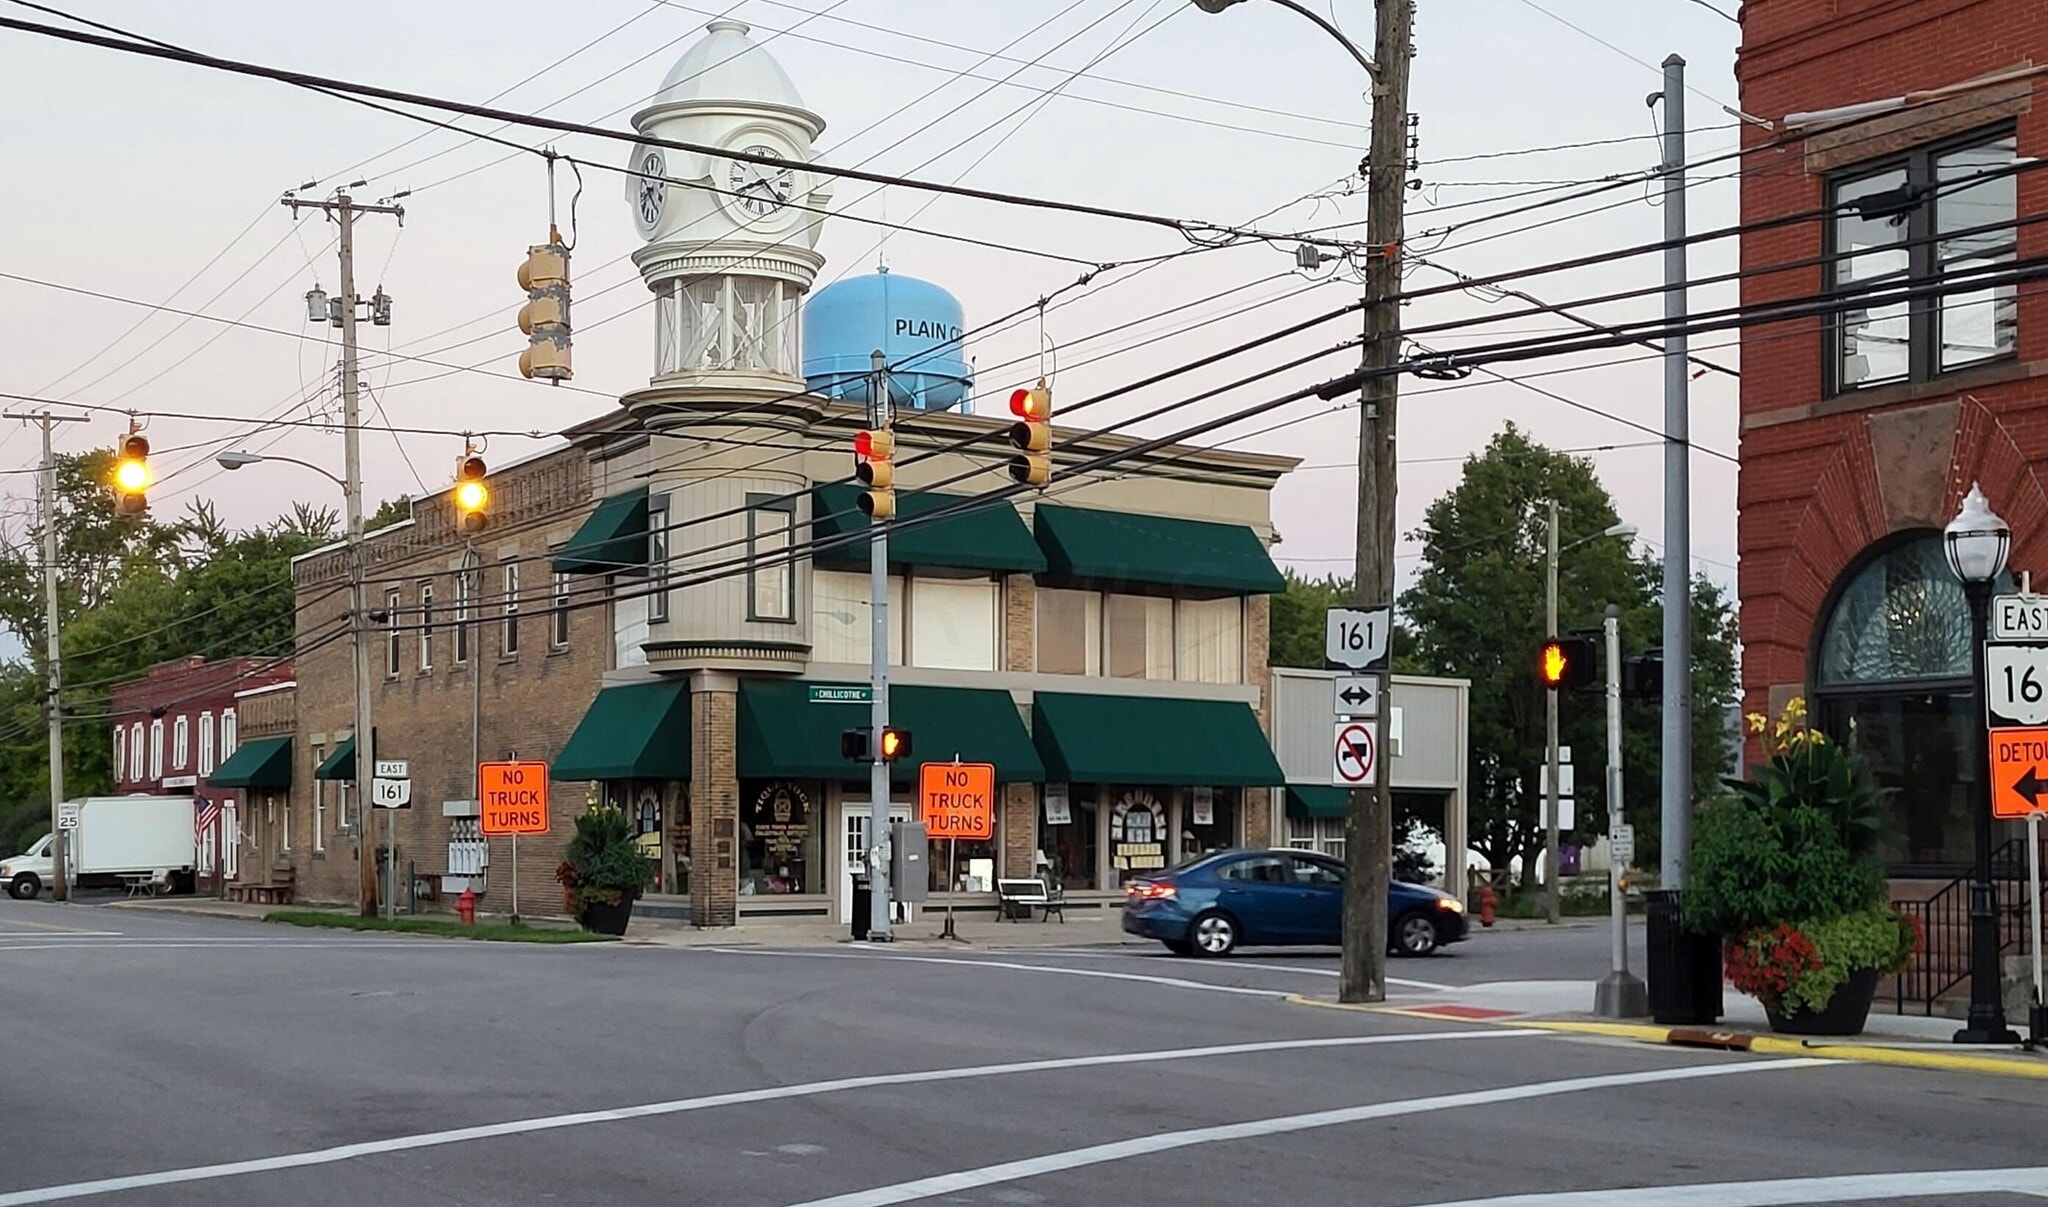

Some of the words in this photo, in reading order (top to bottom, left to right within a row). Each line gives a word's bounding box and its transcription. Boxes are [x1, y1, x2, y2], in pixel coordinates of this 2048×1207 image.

[895, 318, 946, 340] PLAIN
[1340, 621, 1373, 650] 161
[819, 690, 861, 699] CHILLICOTHE
[380, 764, 404, 774] EAST
[502, 771, 524, 785] NO
[946, 771, 968, 787] NO
[381, 785, 402, 799] 161
[488, 791, 540, 806] TRUCK
[929, 793, 984, 809] TRUCK
[60, 817, 77, 827] 25
[488, 811, 540, 827] TURNS
[929, 815, 984, 831] TURNS
